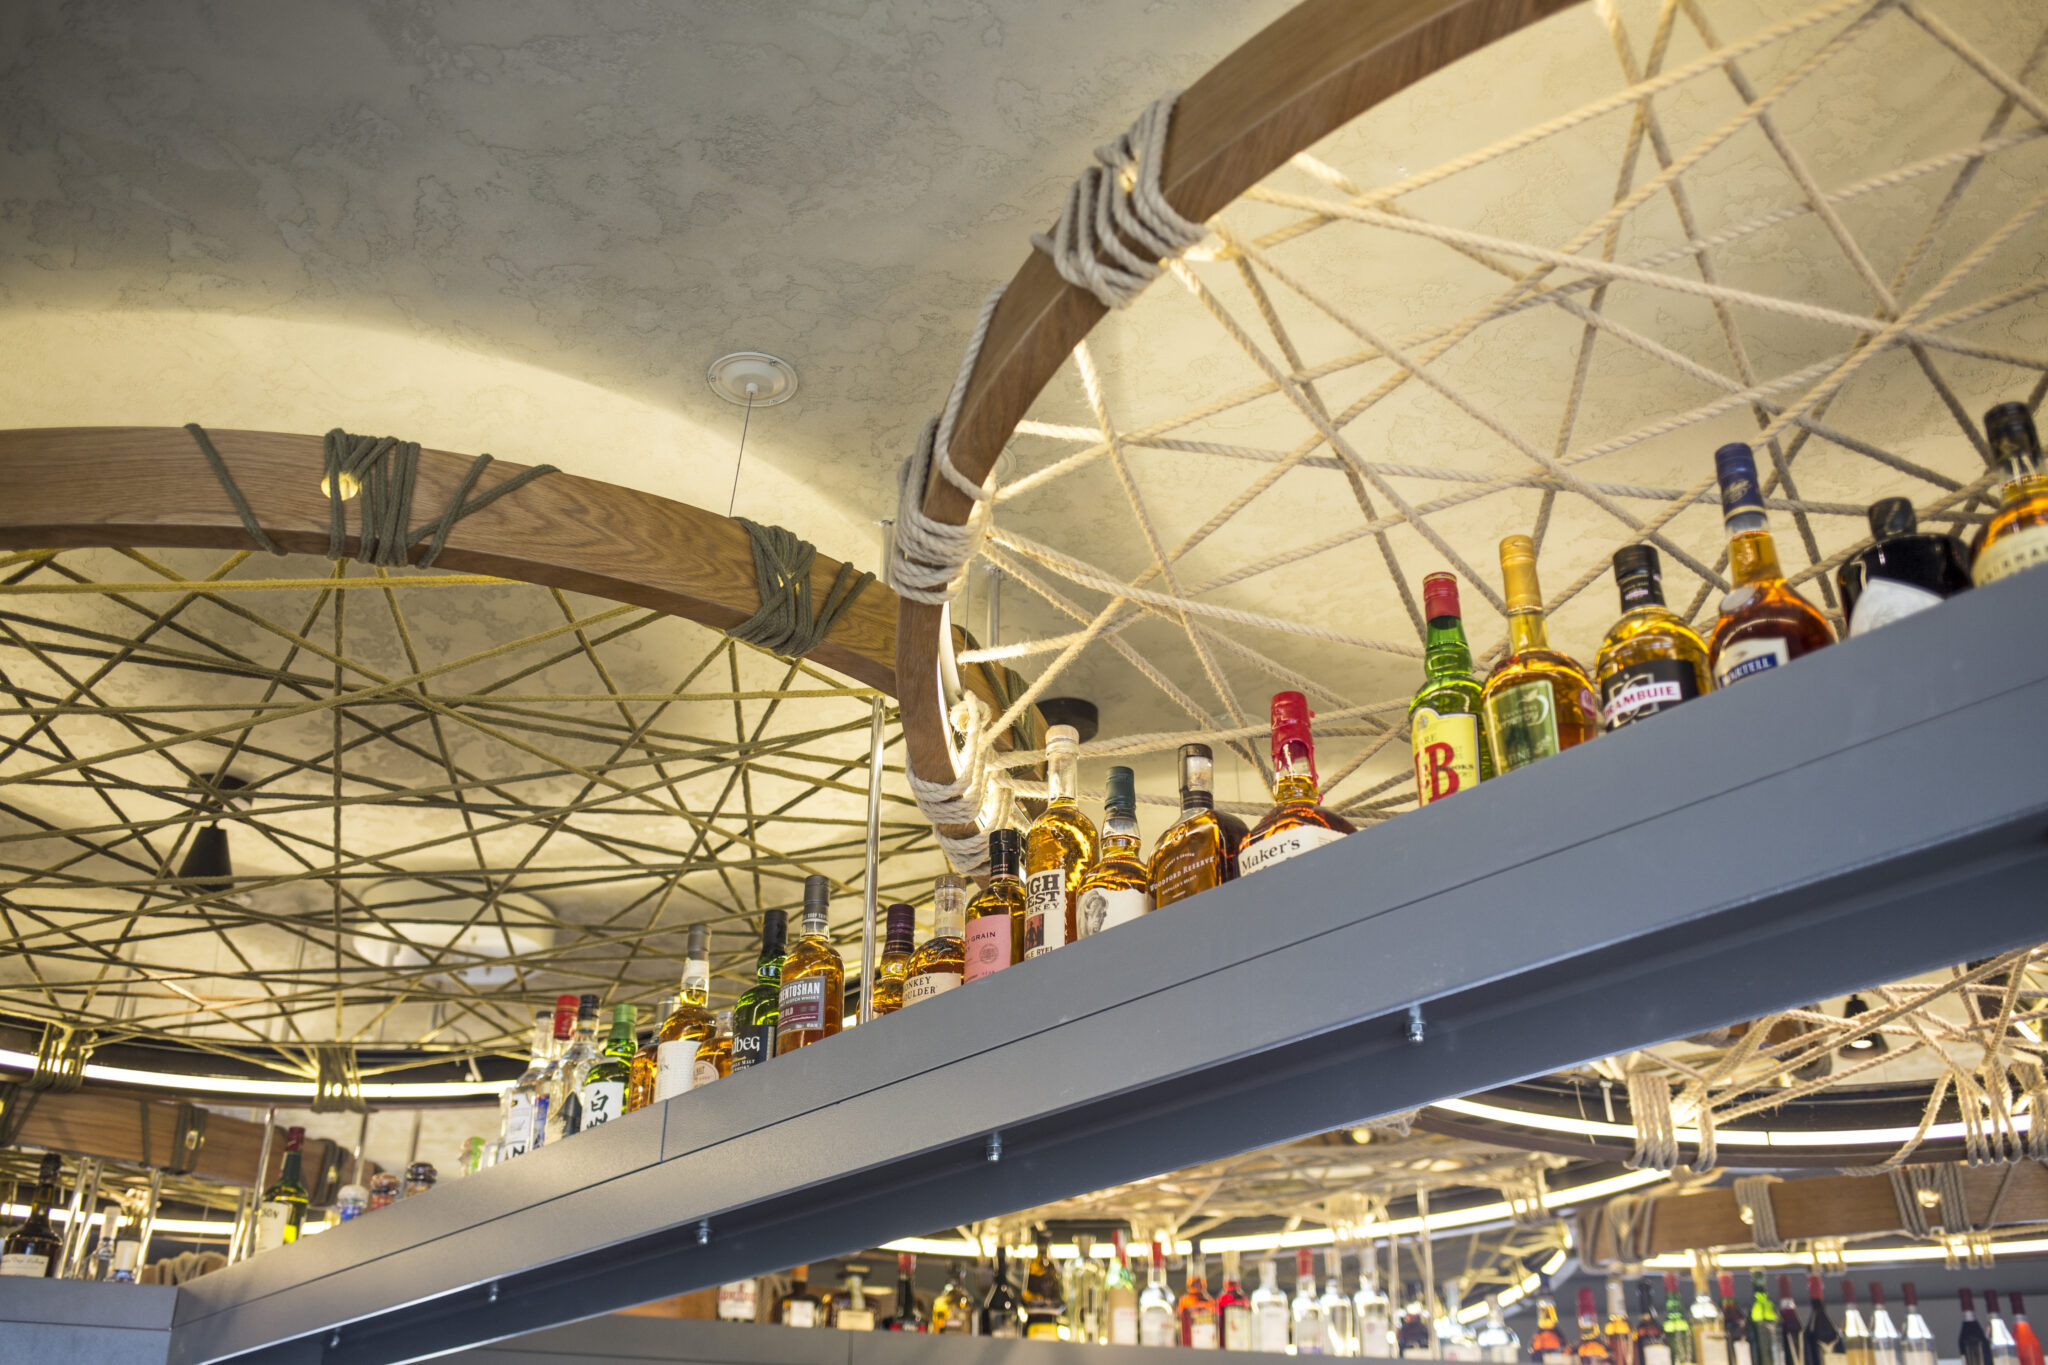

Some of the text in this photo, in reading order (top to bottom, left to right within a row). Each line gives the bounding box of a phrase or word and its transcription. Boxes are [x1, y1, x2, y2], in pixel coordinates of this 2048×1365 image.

[1604, 684, 1675, 720] DRAMBUIE
[1150, 855, 1215, 892] WOODFORD RESERVE
[1241, 839, 1301, 873] Maker's
[970, 931, 996, 943] GRAIN
